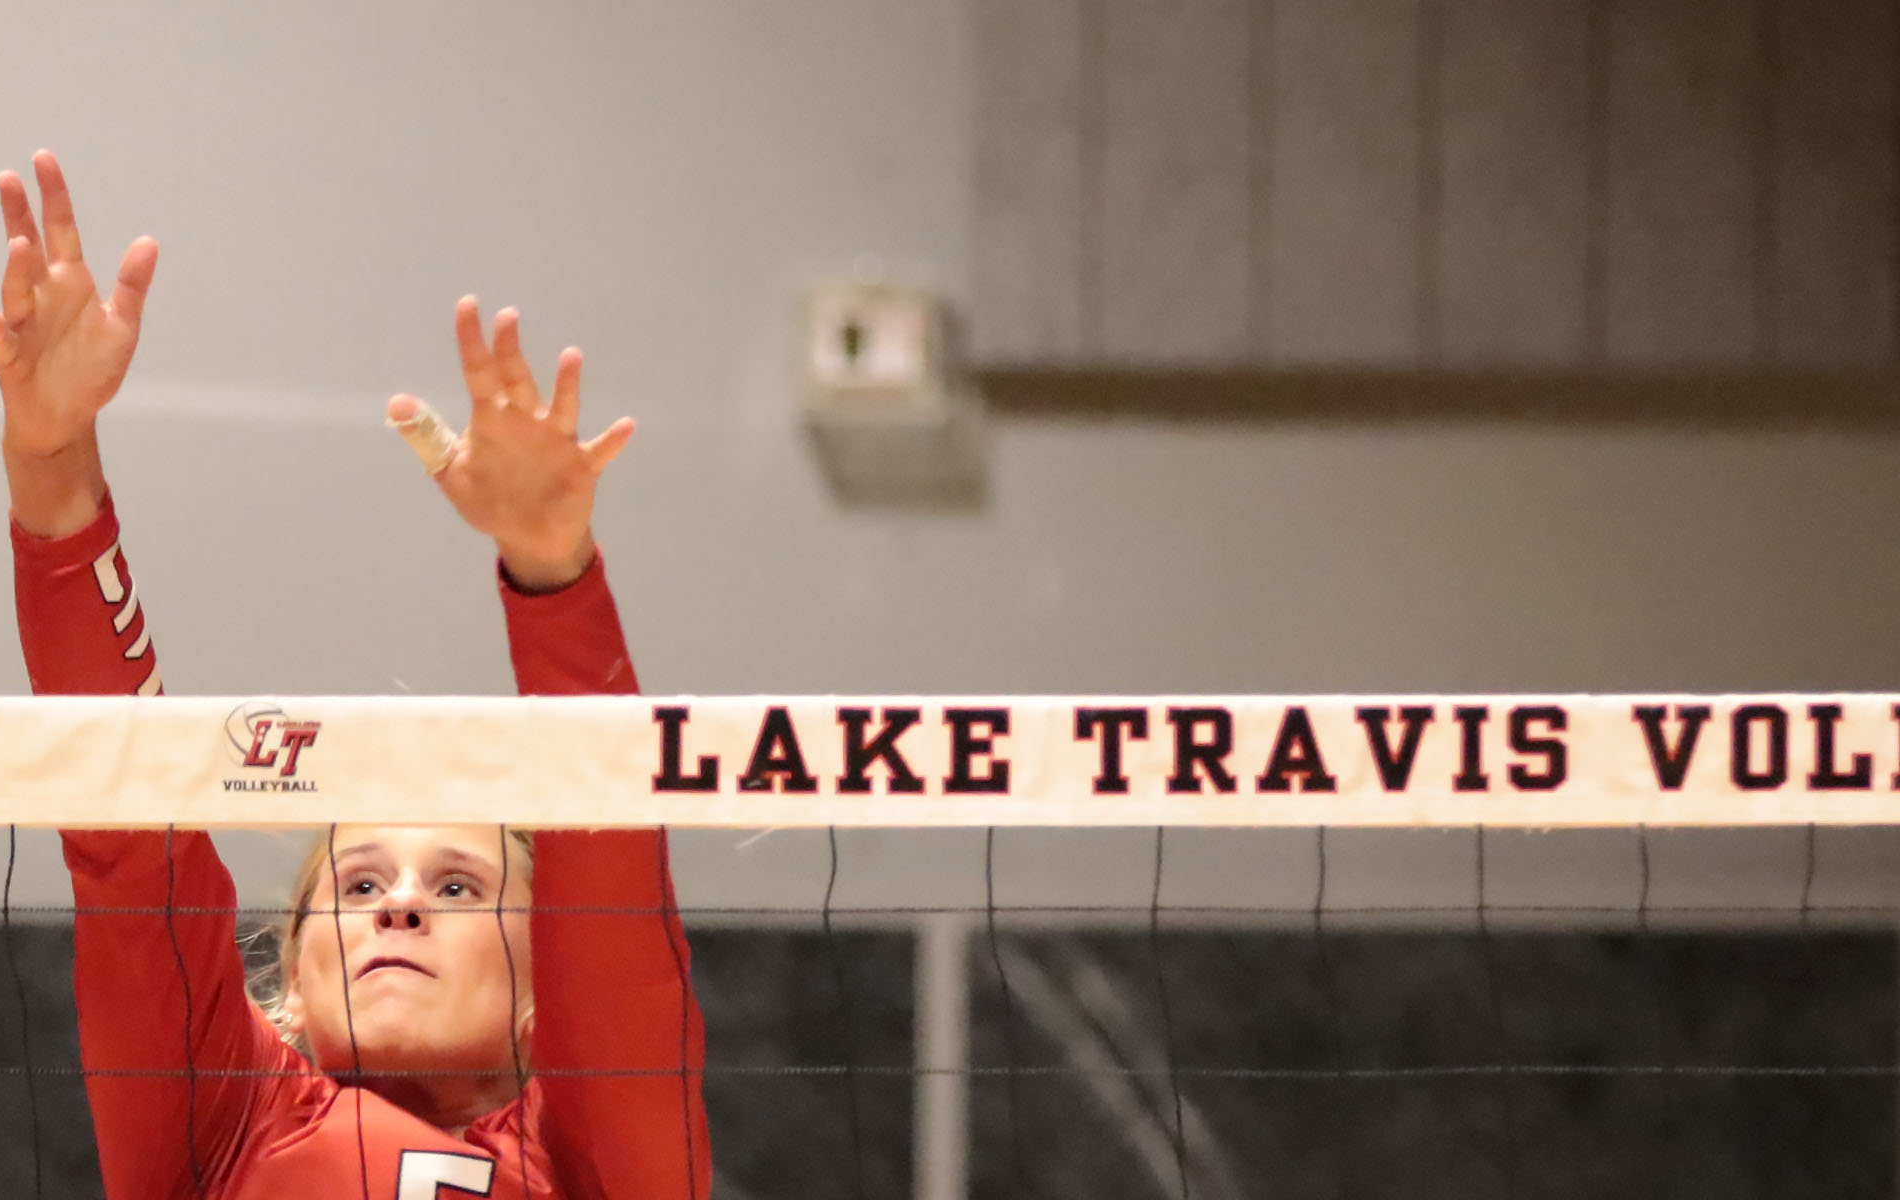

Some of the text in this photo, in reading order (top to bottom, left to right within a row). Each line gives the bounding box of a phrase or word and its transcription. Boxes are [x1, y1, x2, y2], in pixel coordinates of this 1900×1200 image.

[243, 720, 319, 777] LT
[651, 703, 1900, 795] LAKE TRAVIS VOL
[222, 780, 319, 792] VOLLEYBALL
